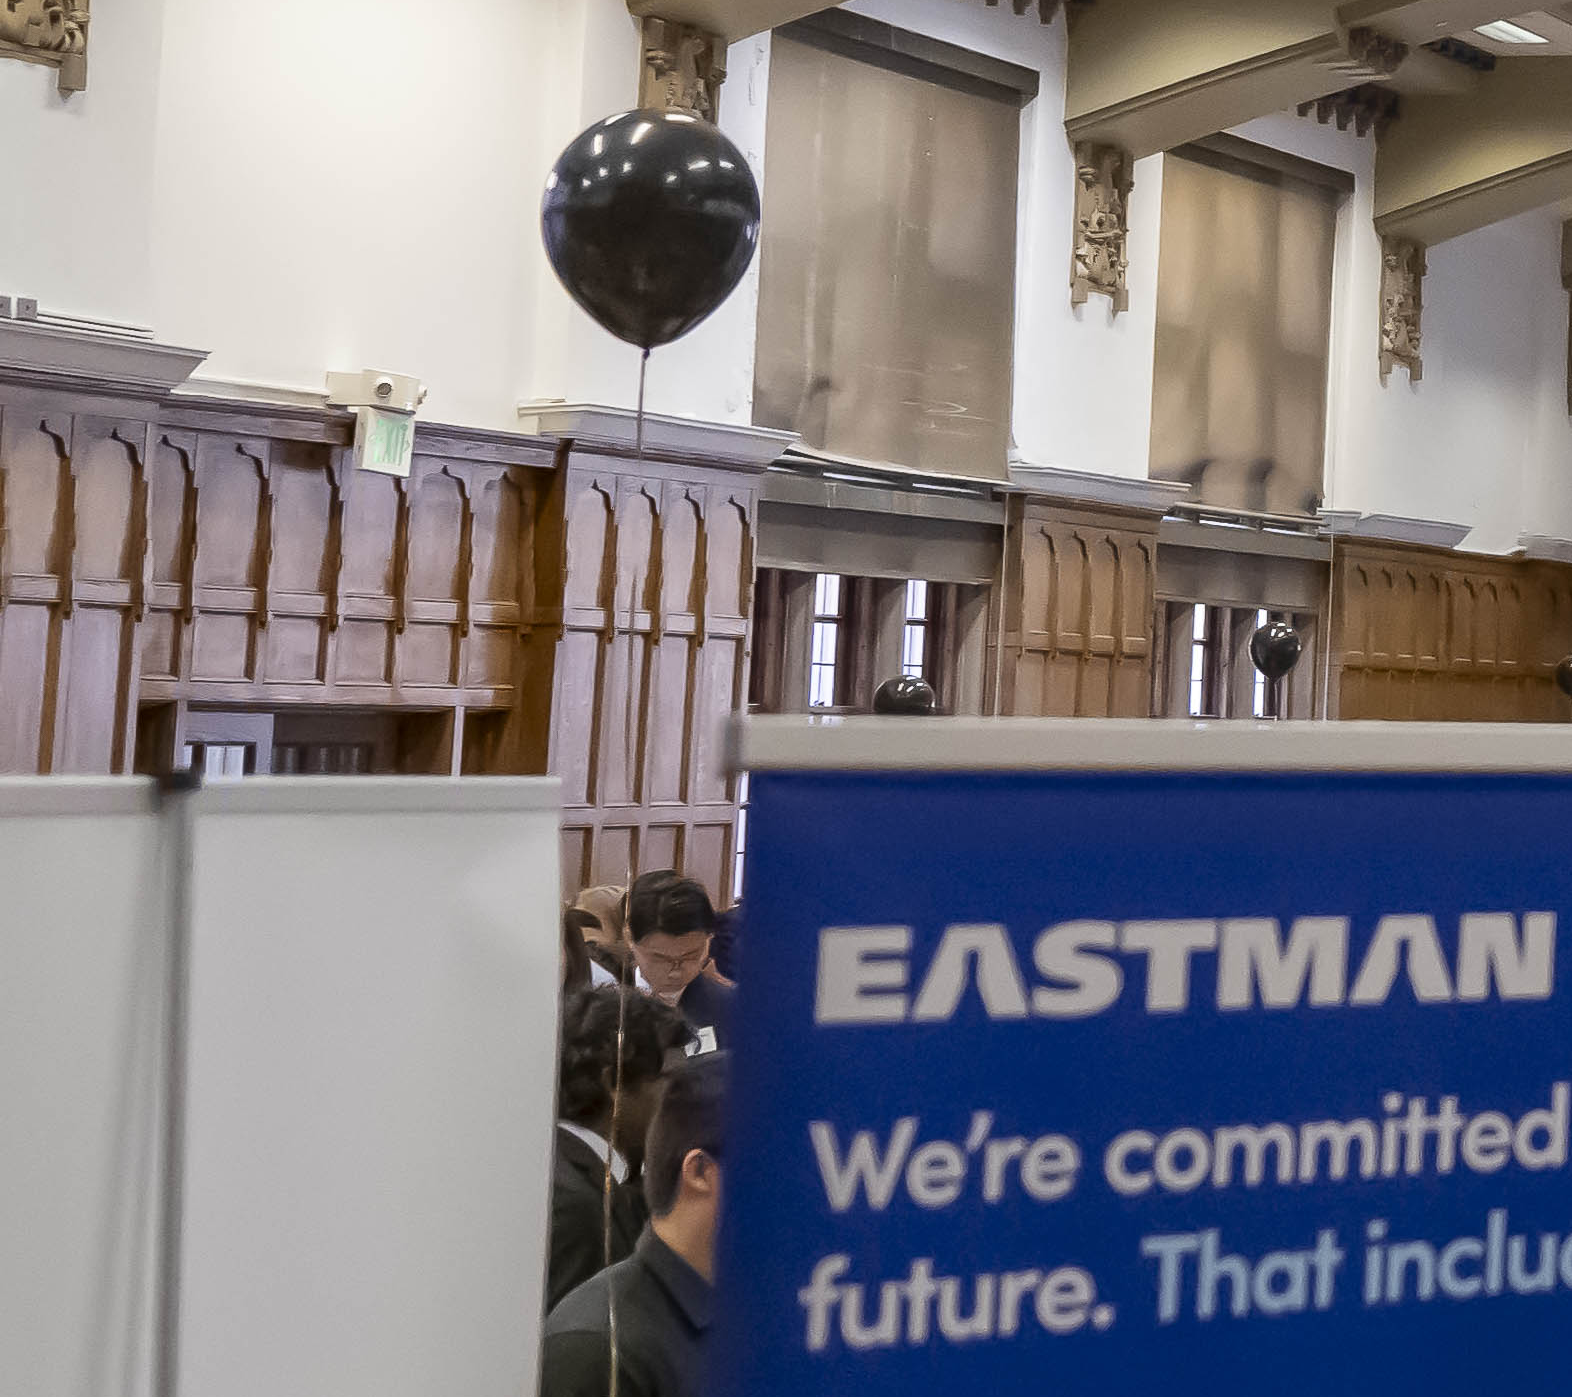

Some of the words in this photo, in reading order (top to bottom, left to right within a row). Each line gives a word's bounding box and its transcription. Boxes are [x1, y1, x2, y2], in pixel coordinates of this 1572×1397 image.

[814, 911, 1557, 1024] EASTMAN
[809, 1111, 1080, 1211] We're
[1104, 1082, 1570, 1196] committed
[797, 1253, 1118, 1352] future.
[1141, 1227, 1342, 1322] That
